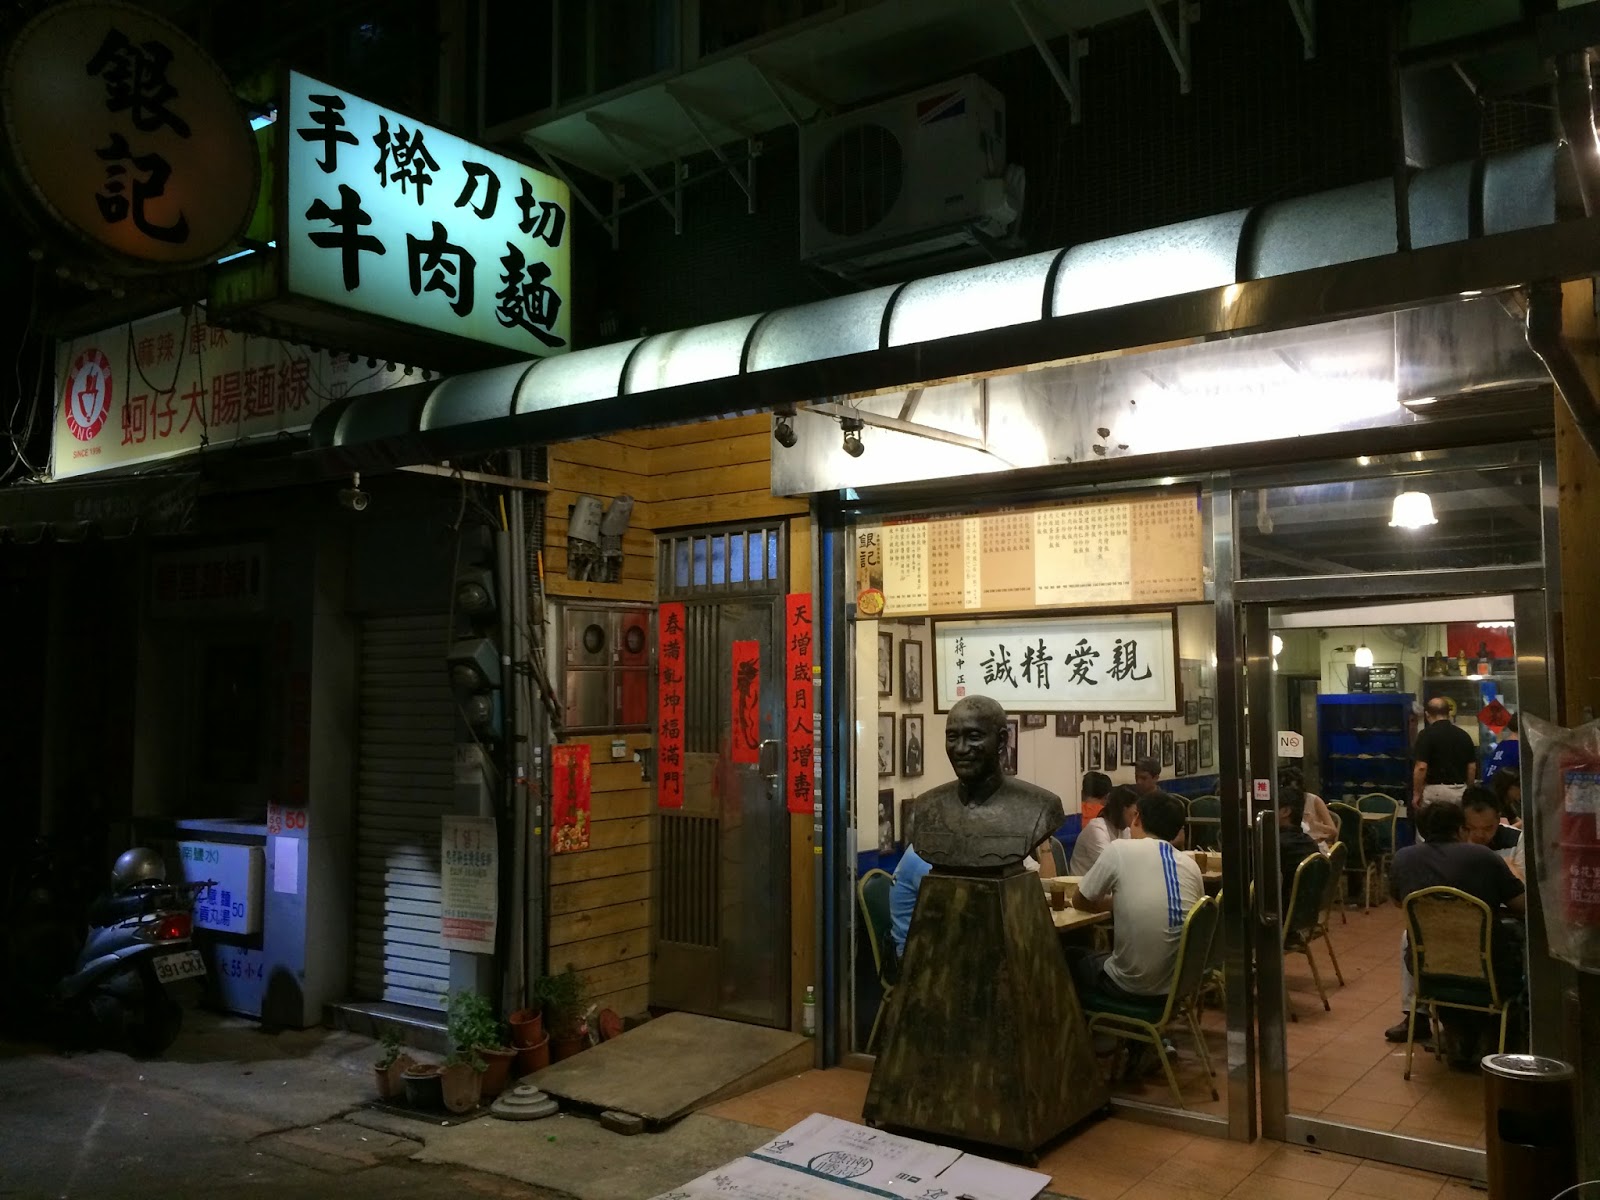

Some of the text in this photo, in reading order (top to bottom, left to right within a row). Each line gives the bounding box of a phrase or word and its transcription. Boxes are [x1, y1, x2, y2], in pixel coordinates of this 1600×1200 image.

[87, 27, 192, 244] 銀記
[296, 95, 566, 248] 手擀刀切
[305, 184, 567, 348] 牛肉麵
[858, 533, 876, 568] 銀記
[954, 637, 967, 685] 蔣中正
[791, 605, 813, 802] 天增歲月人增壽
[1257, 782, 1268, 791] 推
[286, 811, 306, 830] 50
[232, 902, 244, 918] 50
